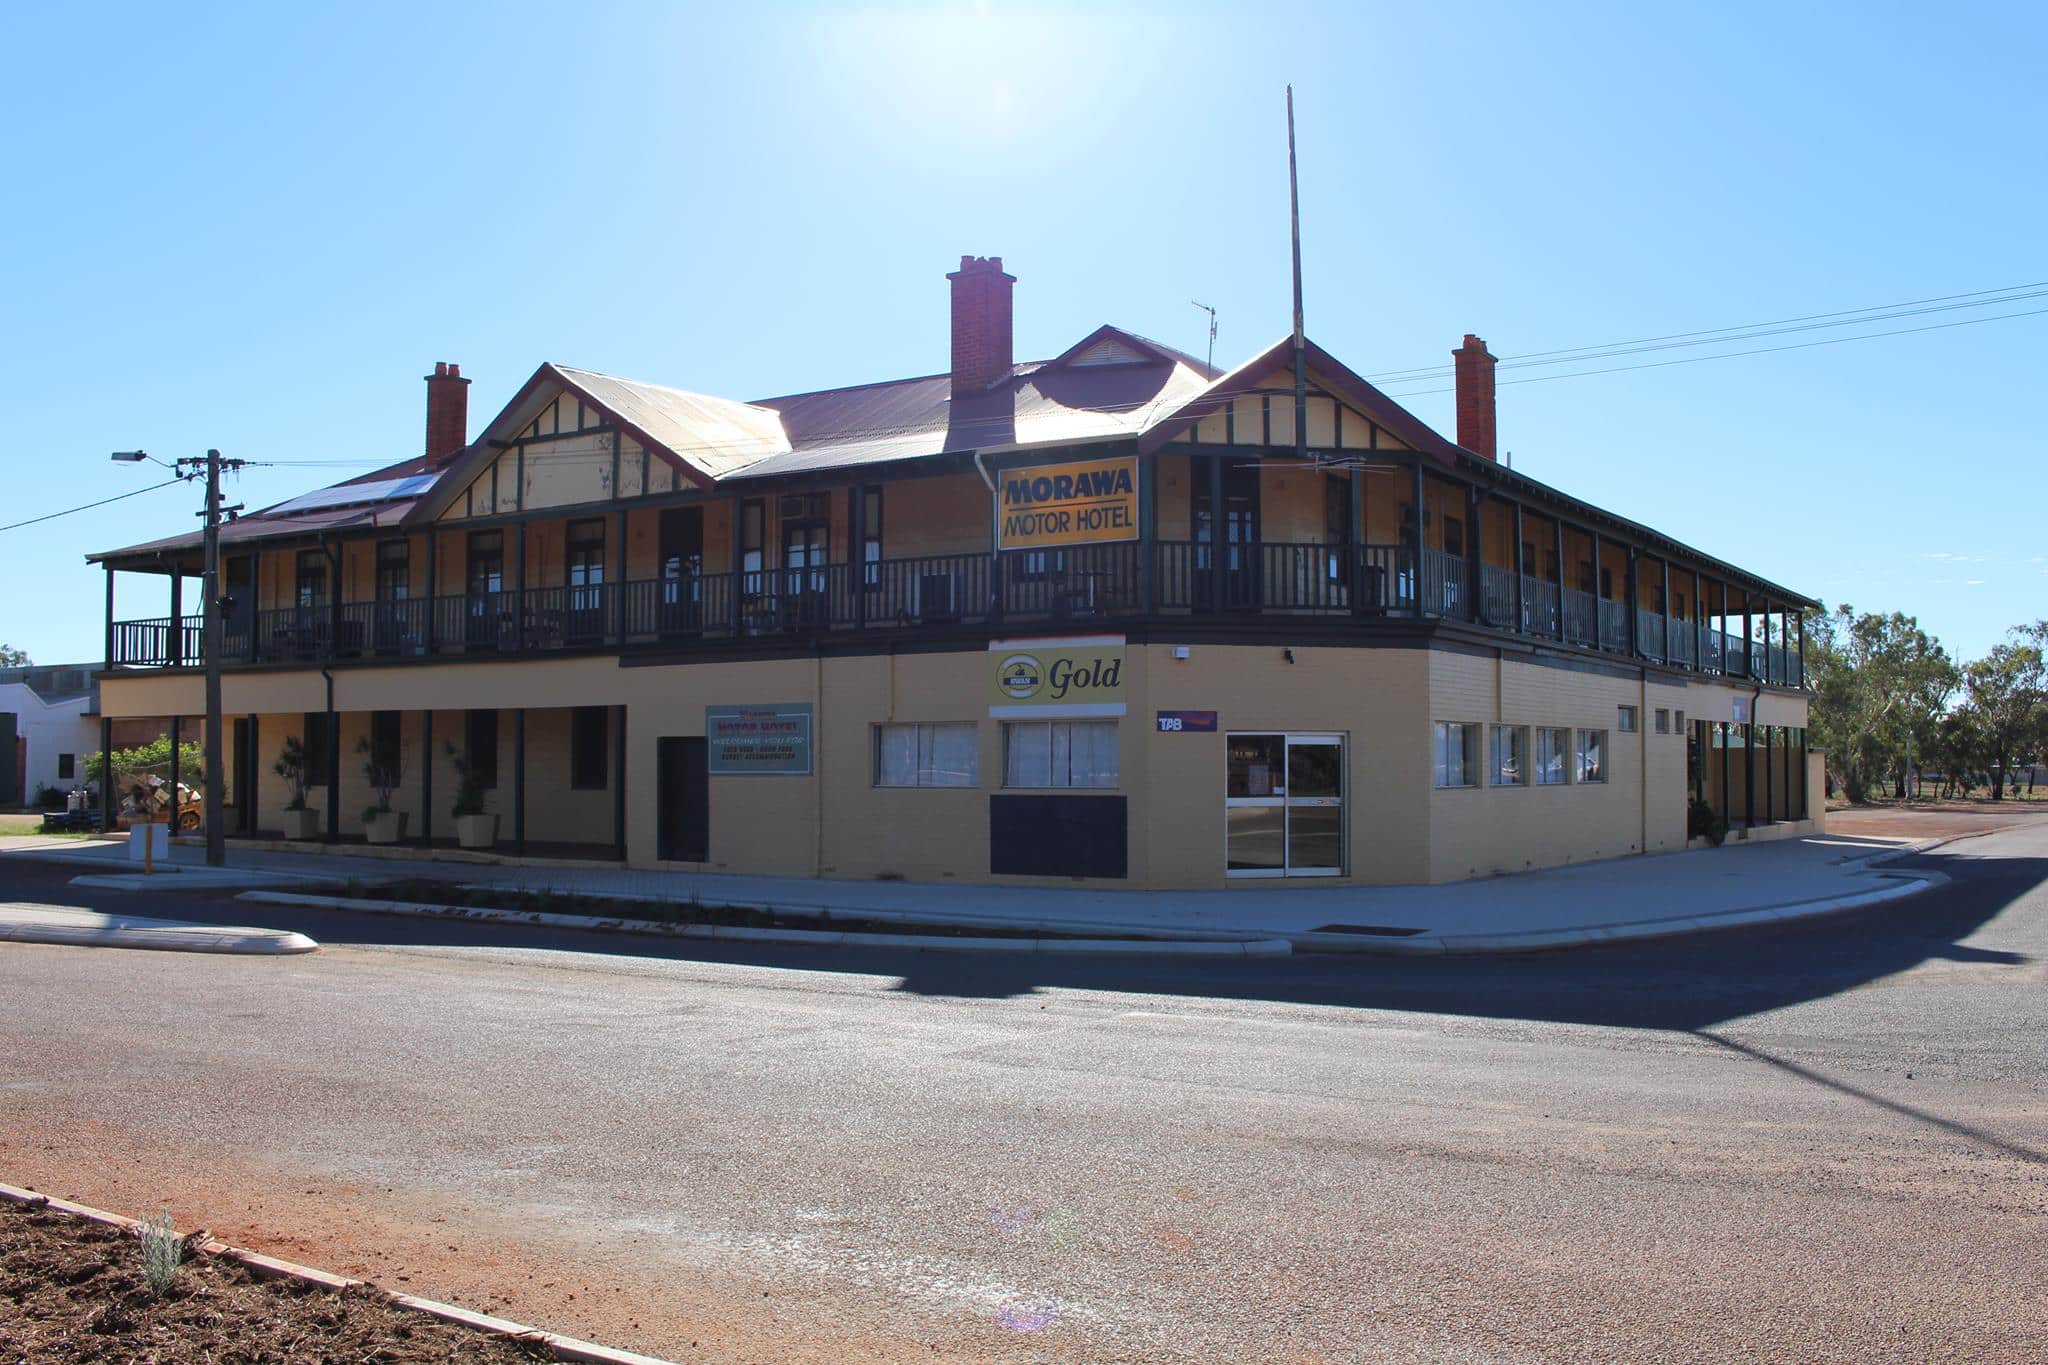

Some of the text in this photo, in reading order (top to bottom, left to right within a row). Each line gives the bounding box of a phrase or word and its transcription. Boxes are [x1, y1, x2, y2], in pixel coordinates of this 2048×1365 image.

[1005, 468, 1133, 505] MORAWA
[1004, 505, 1132, 537] MOTOR HOTEL
[1050, 658, 1121, 699] Gold
[1158, 718, 1182, 731] TAB
